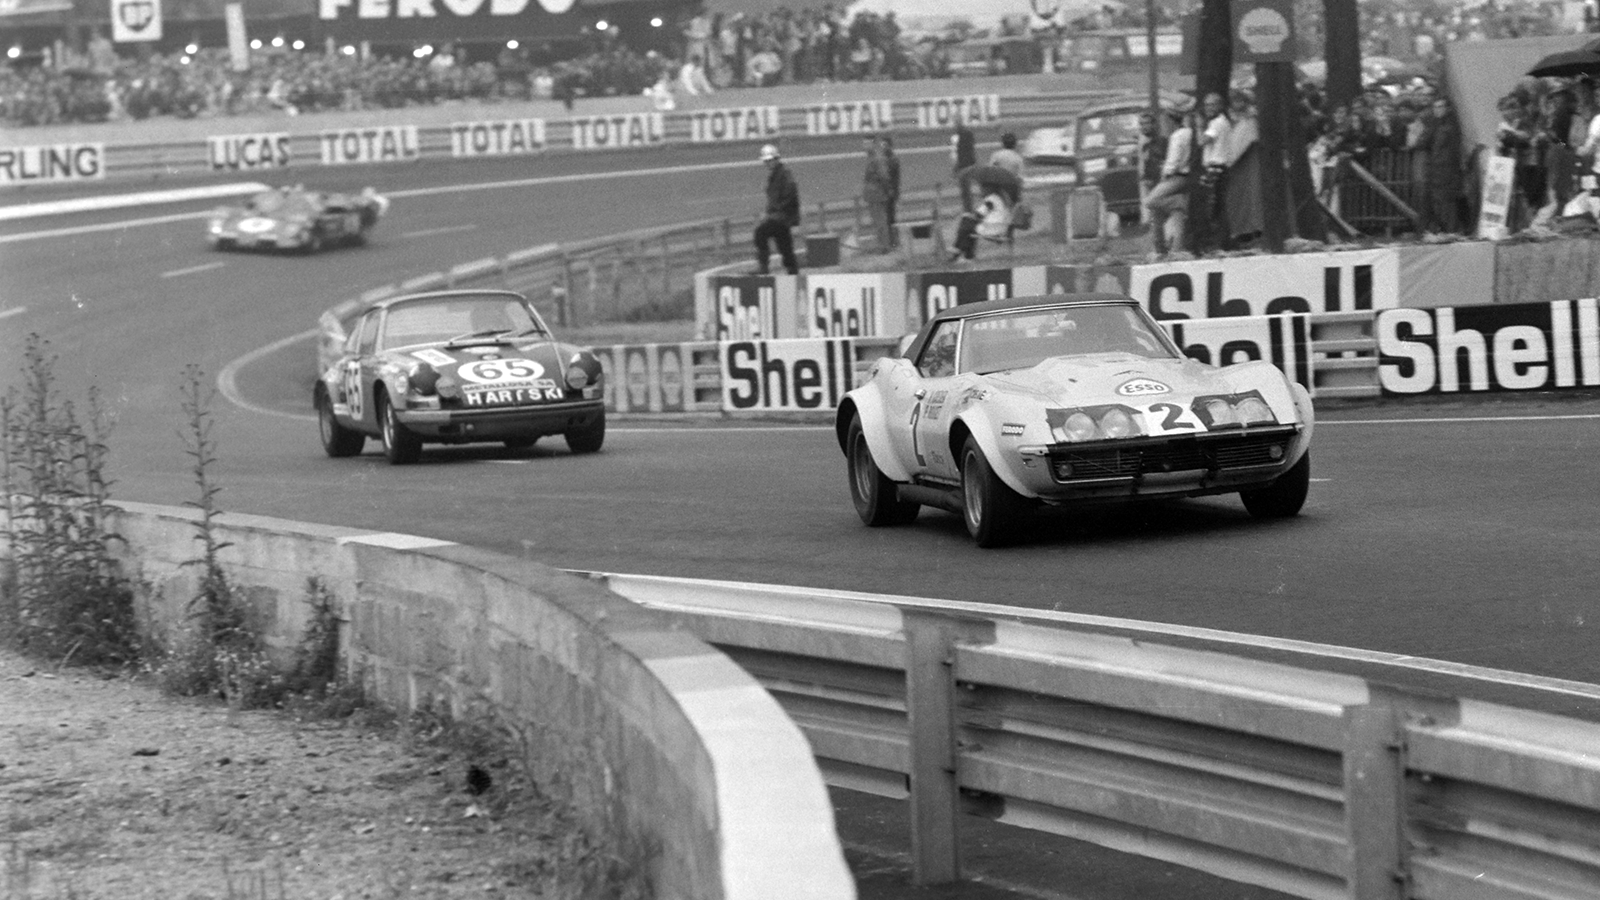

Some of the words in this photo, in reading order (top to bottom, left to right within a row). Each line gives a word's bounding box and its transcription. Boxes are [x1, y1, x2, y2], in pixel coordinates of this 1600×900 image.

[693, 108, 776, 141] TOTAL
[810, 102, 890, 134] TOTAL
[921, 96, 997, 128] TOTAL
[324, 129, 415, 162] TOTAL
[452, 121, 542, 156] TOTAL
[576, 115, 660, 147] TOTAL
[212, 138, 289, 169] LUCAS
[719, 286, 773, 340] Shell
[815, 287, 875, 337] Shell
[1378, 298, 1600, 393] Shell
[473, 359, 535, 380] 65
[728, 340, 854, 408] Shell
[1149, 403, 1196, 431] 2
[910, 402, 926, 466] 2
